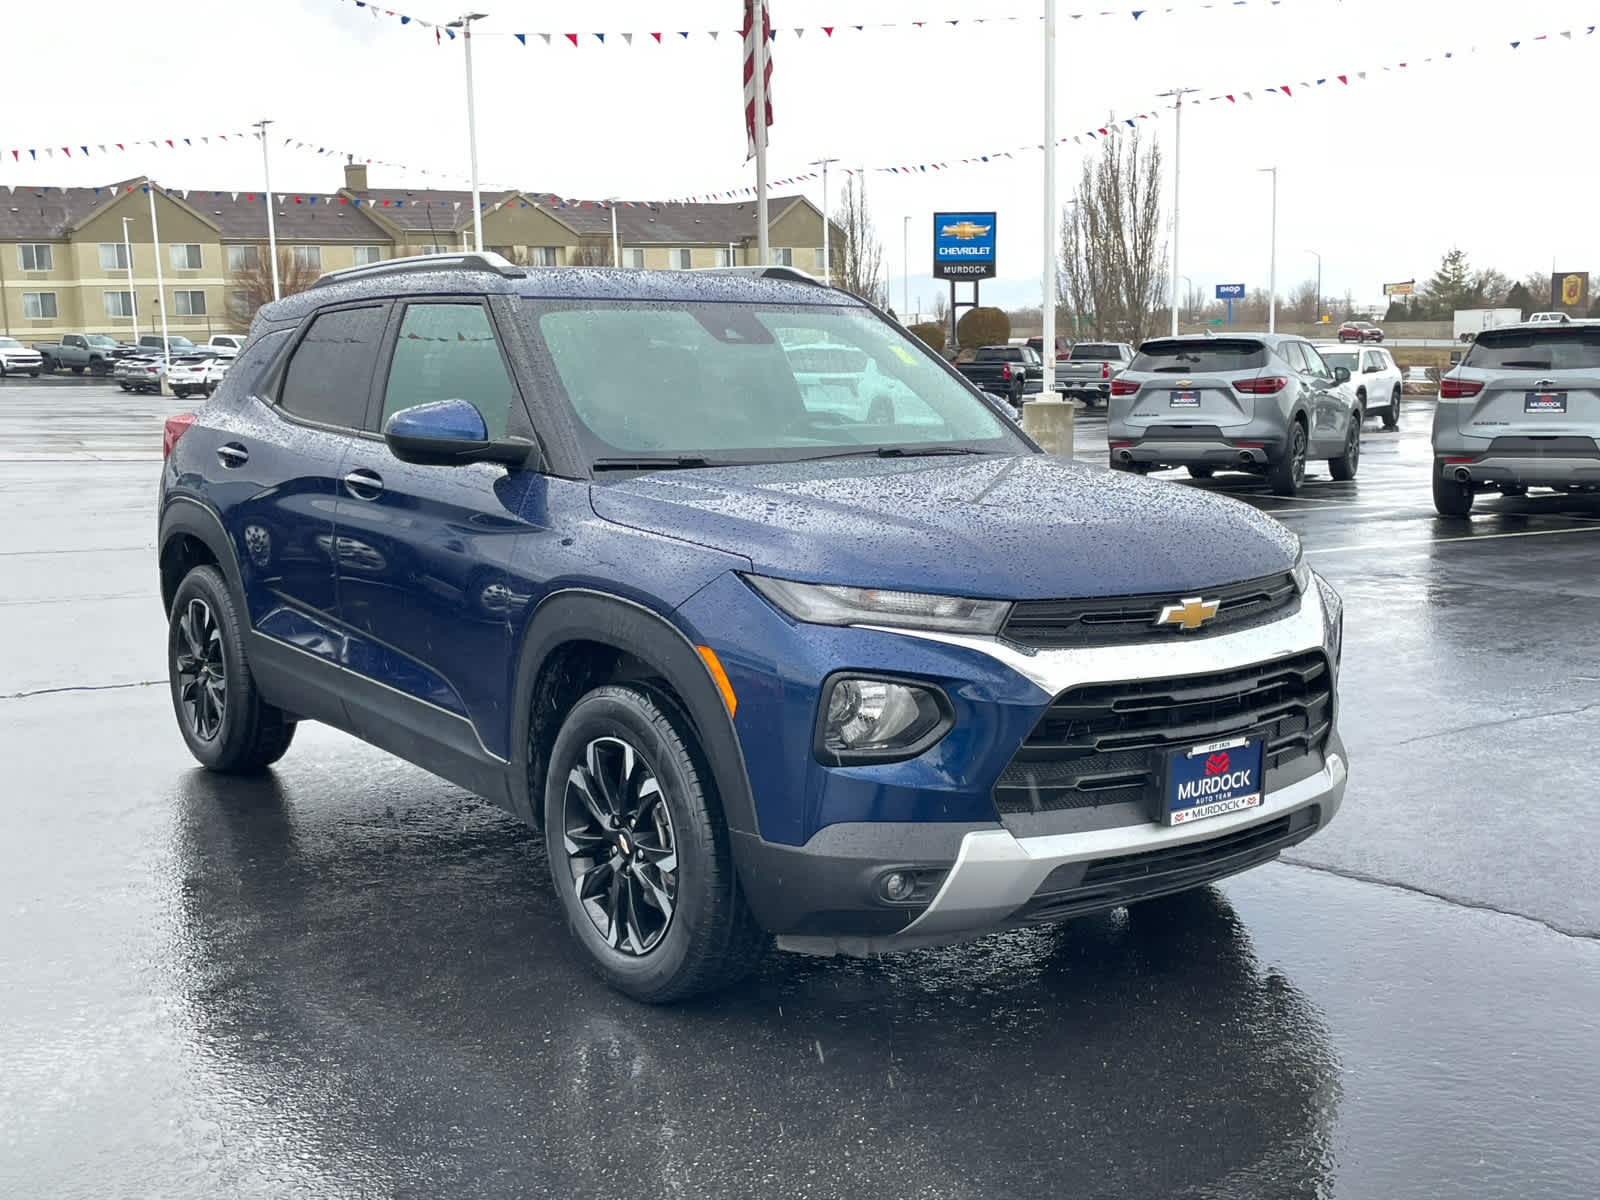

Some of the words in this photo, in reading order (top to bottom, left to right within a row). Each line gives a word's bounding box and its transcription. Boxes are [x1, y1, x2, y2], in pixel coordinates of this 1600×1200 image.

[939, 247, 991, 255] CHEVROLET
[944, 265, 986, 274] MURDOCK
[1178, 769, 1251, 800] MURDOCK
[1195, 796, 1213, 805] AUTO
[1215, 791, 1232, 801] TEAM
[1192, 799, 1240, 818] MURDOCK
